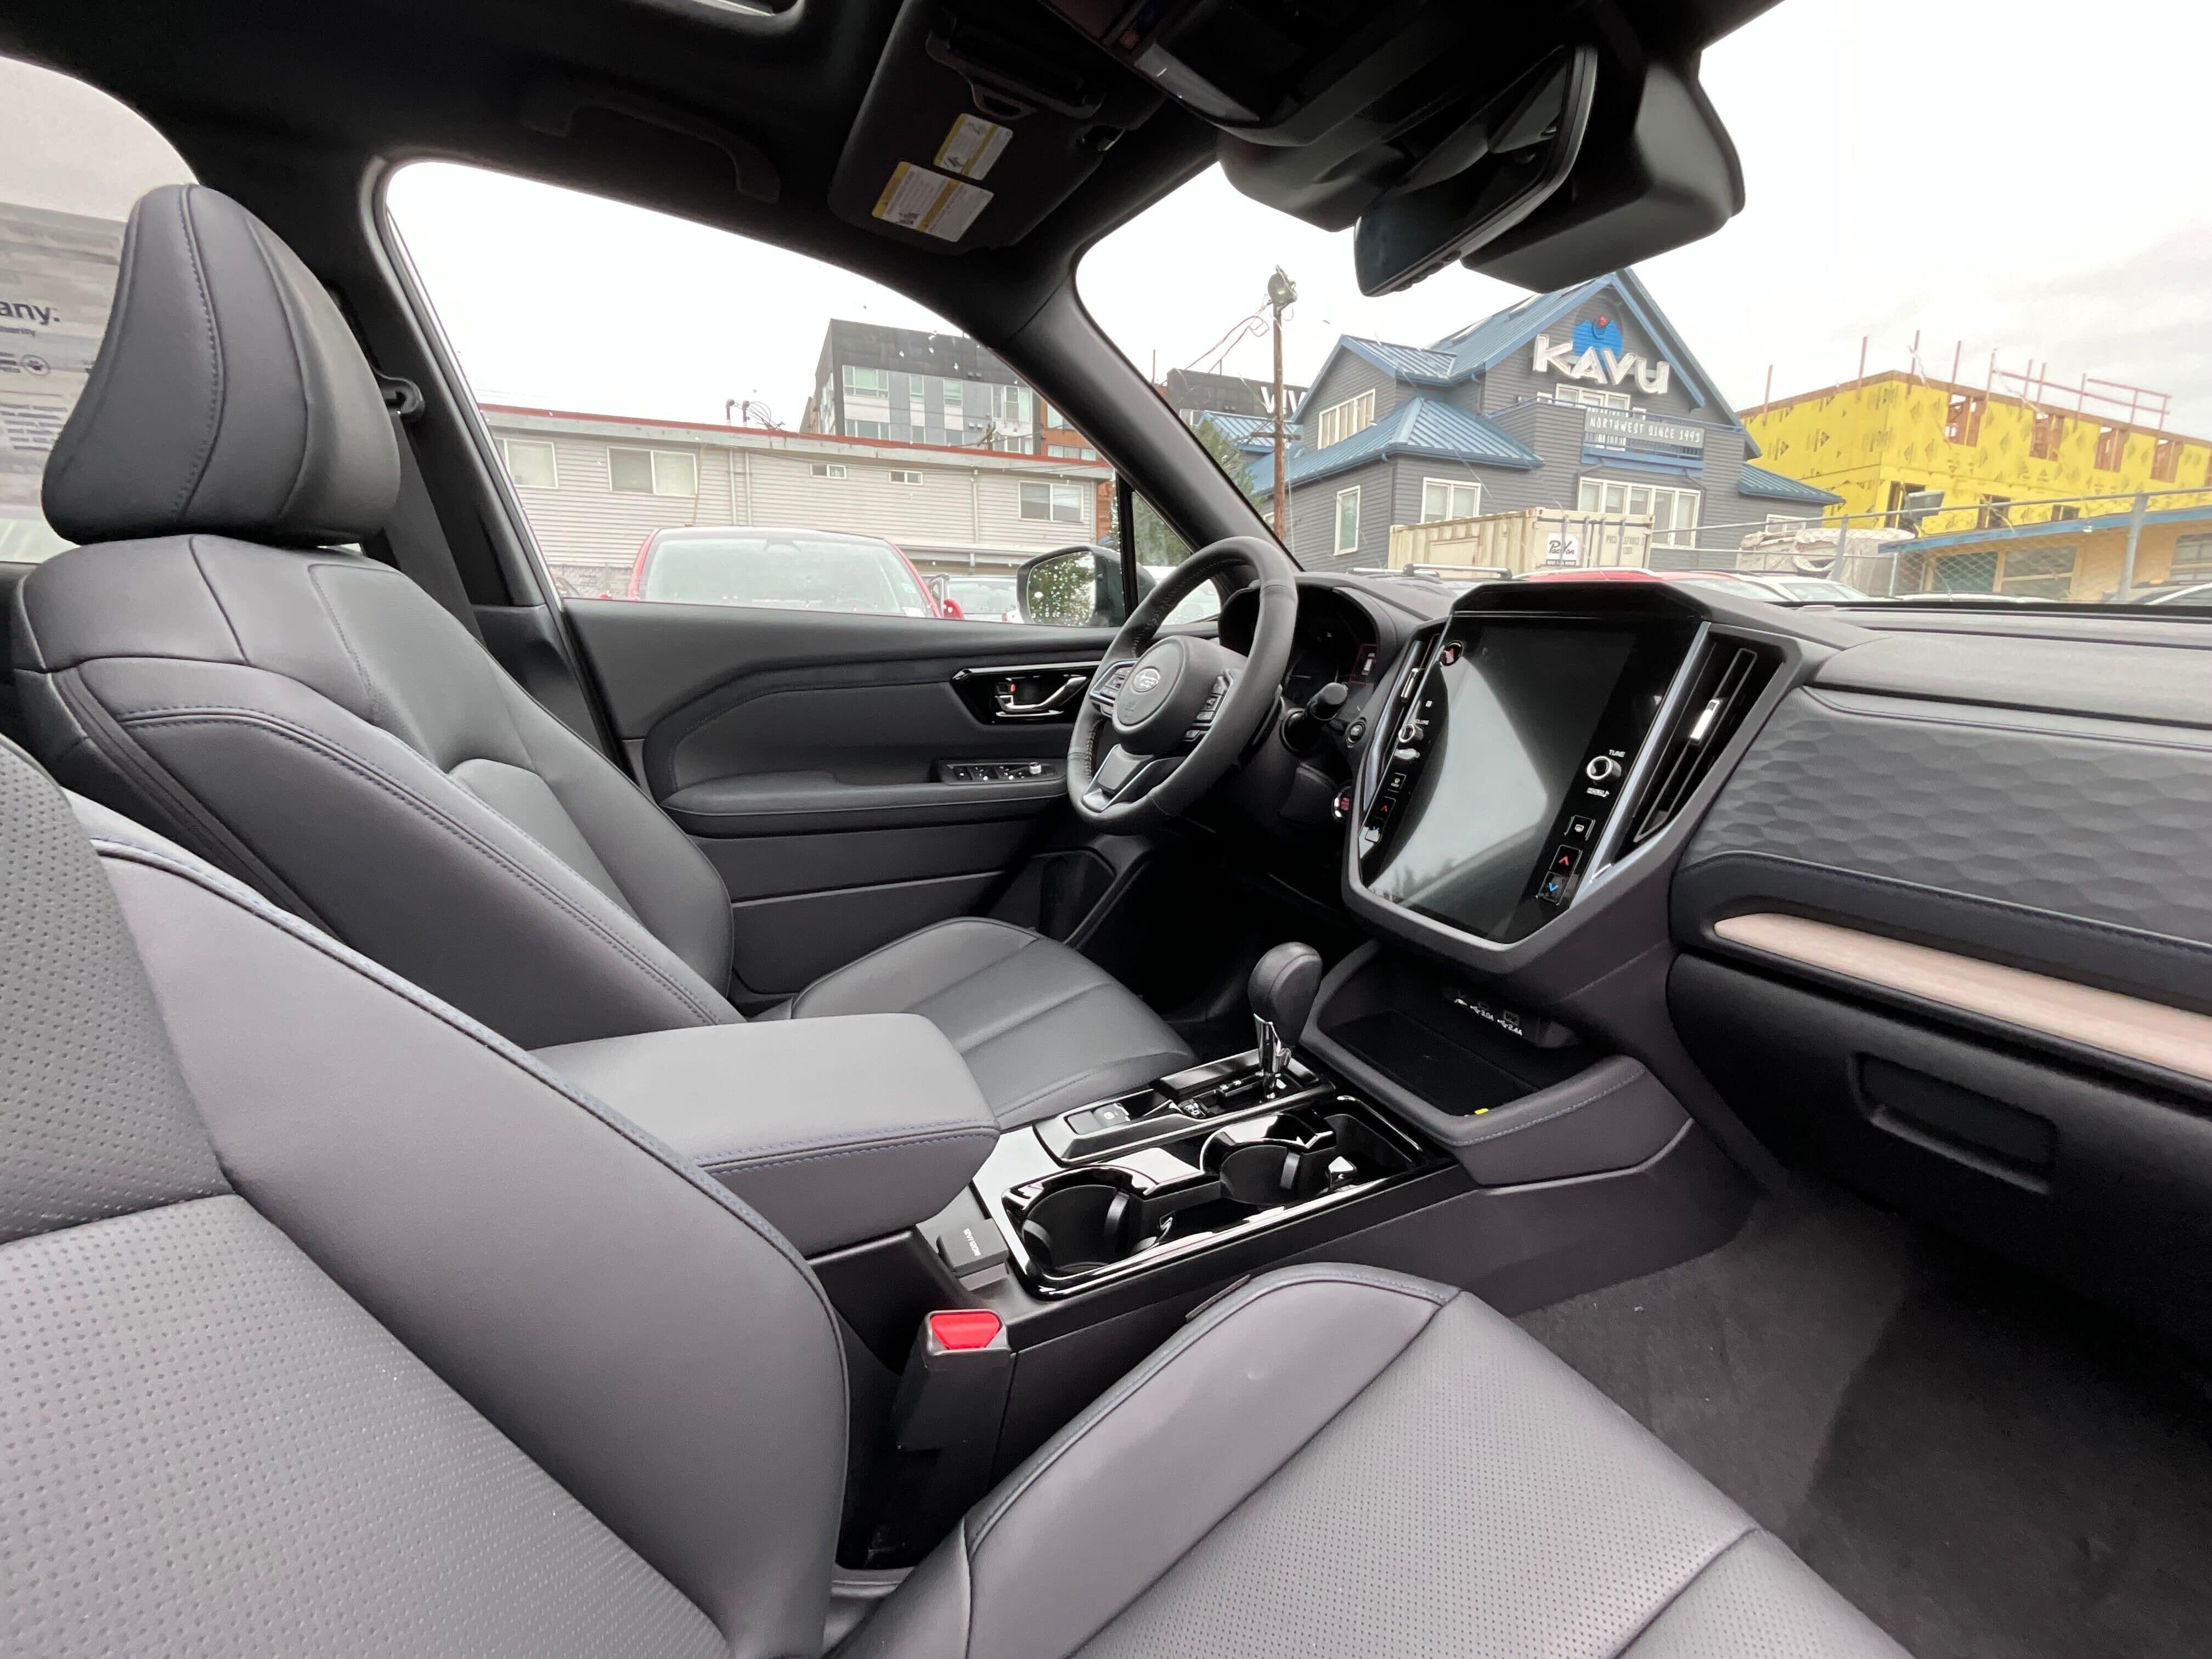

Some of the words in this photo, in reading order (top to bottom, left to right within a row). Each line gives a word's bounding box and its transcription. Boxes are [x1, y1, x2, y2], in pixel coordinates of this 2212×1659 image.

[1533, 334, 1670, 394] KAVU
[1590, 416, 1644, 435] NORTHWEST
[1648, 425, 1675, 439] SINCE
[1679, 430, 1701, 443] 1993
